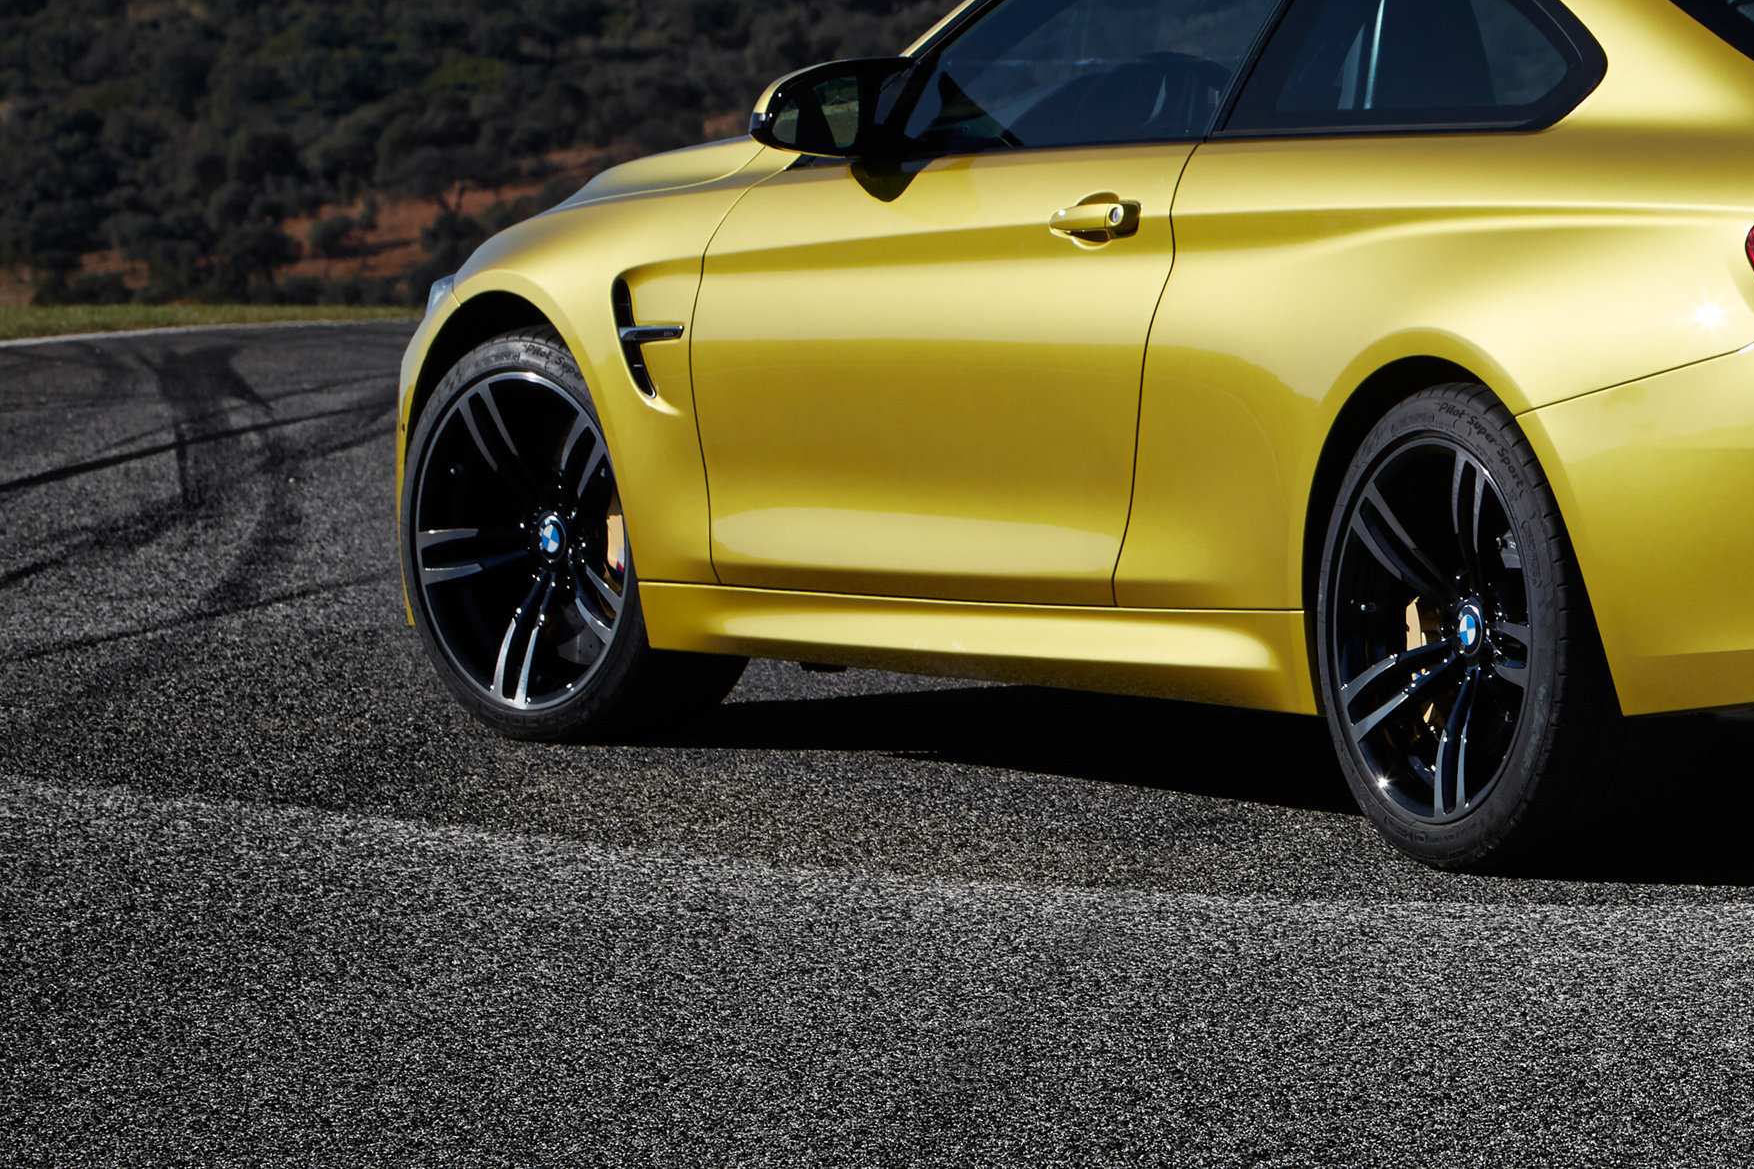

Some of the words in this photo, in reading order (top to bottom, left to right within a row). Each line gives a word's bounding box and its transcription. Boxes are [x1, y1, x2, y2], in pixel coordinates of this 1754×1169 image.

[525, 344, 551, 360] Pilot
[1438, 402, 1465, 419] Pilot
[1467, 415, 1497, 444] Super
[1497, 447, 1524, 487] Sport
